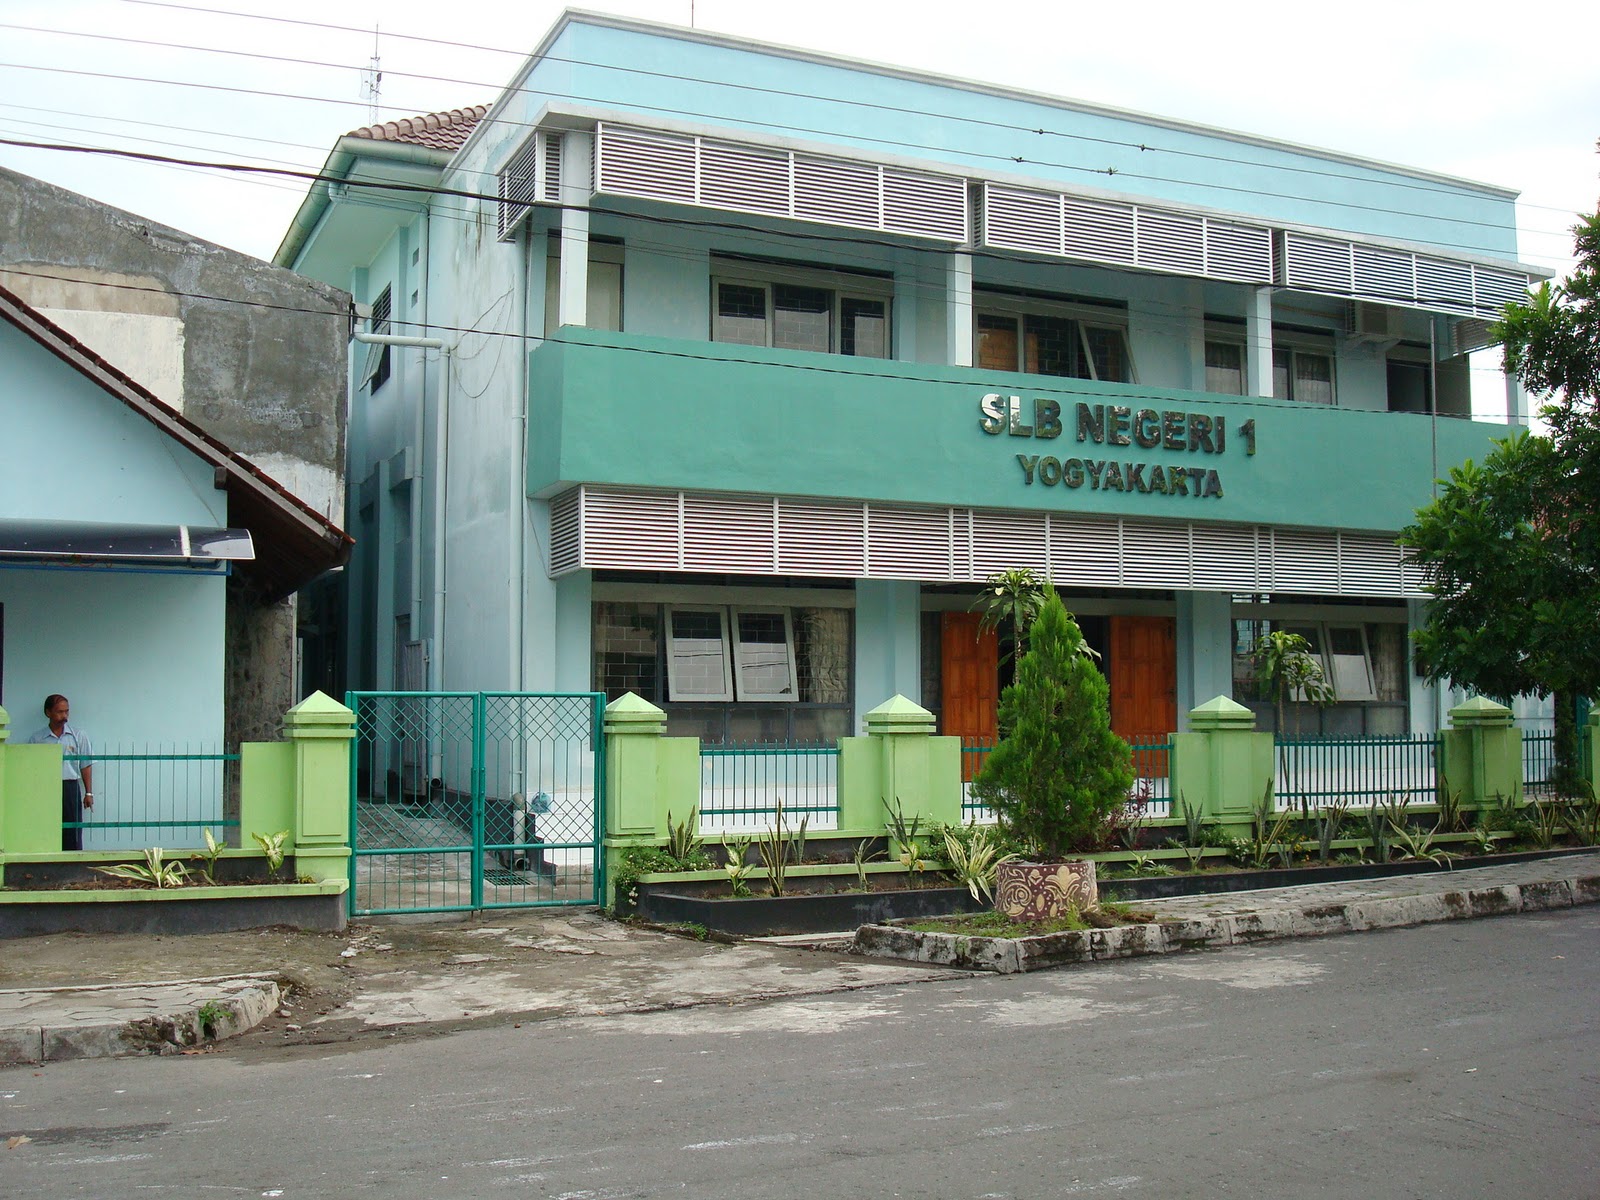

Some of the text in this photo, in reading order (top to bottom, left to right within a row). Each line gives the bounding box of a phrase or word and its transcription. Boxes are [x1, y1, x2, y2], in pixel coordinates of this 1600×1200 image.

[979, 393, 1256, 456] SLB NEGERI 1
[1016, 453, 1224, 498] YOGYAKARTA
